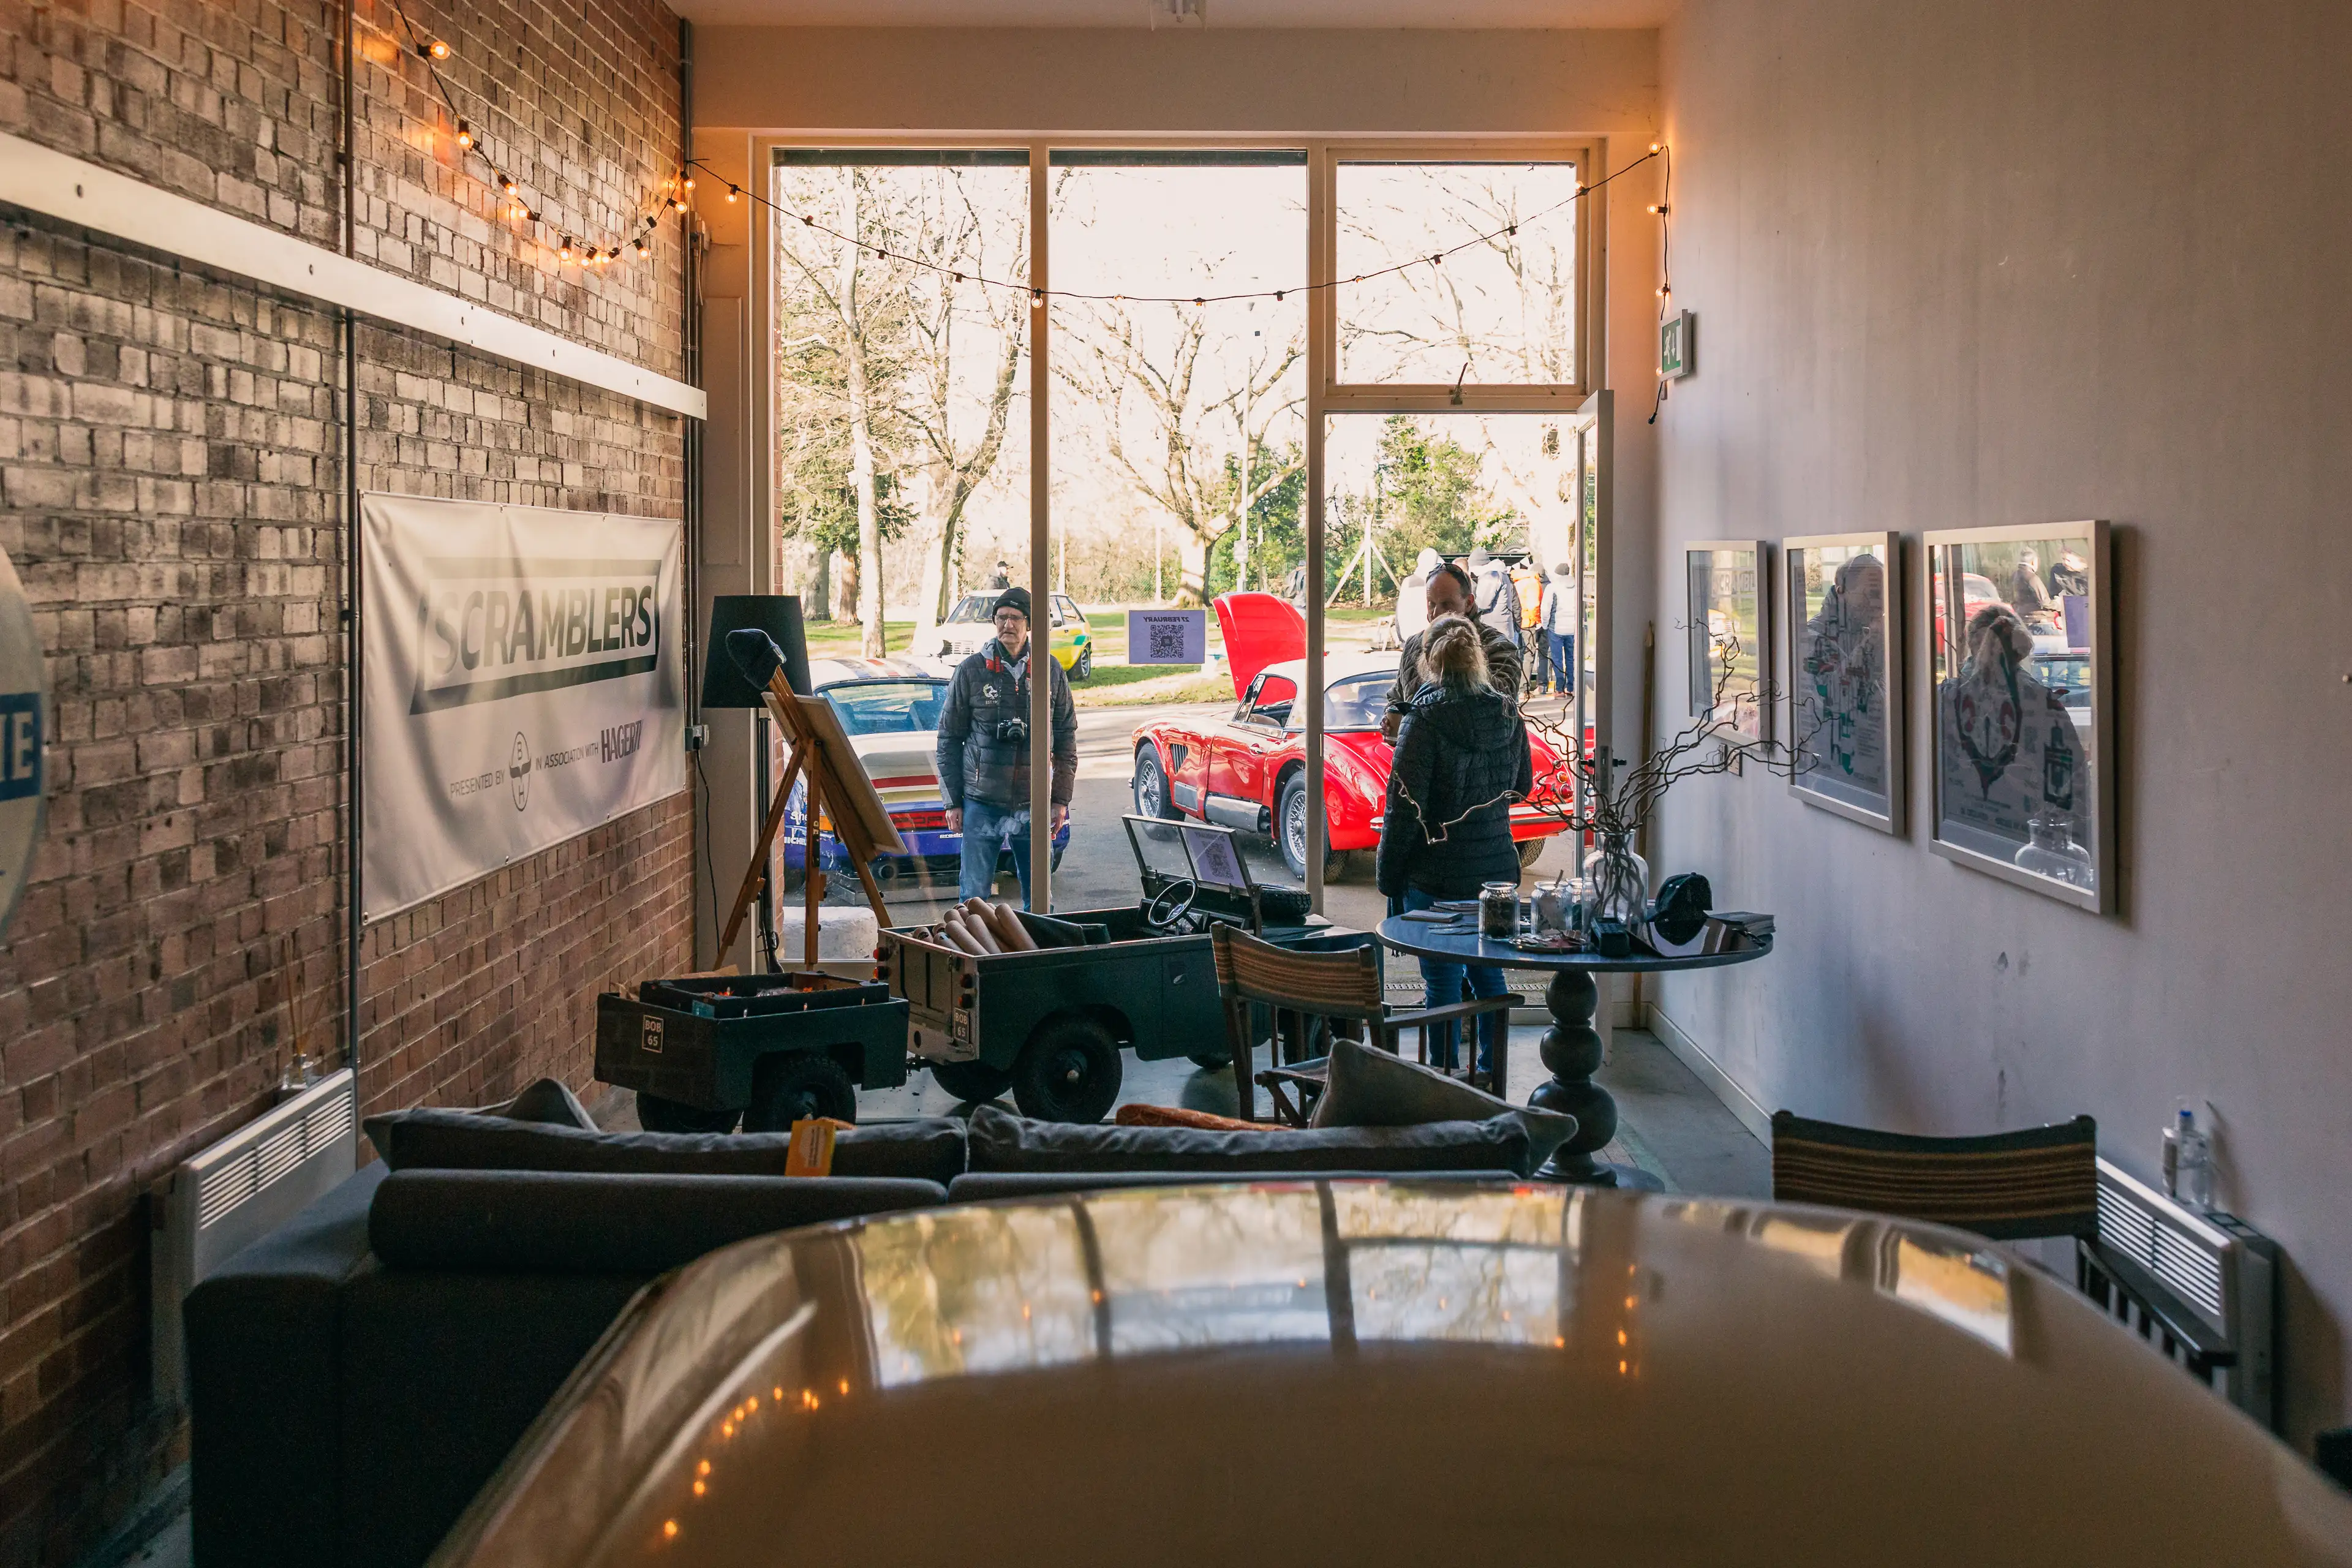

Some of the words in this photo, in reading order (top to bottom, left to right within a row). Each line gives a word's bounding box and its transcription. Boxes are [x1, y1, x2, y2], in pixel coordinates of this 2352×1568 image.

[432, 585, 652, 675] SCRAMBLERS
[516, 741, 523, 760] B
[535, 757, 542, 771] IN
[544, 746, 584, 769] ASSOCIATION
[585, 742, 599, 758] WITH
[450, 773, 492, 799] PRESENTED
[496, 770, 506, 785] BY
[518, 784, 525, 805] H
[644, 1020, 662, 1033] BOB
[955, 1012, 968, 1025] BOB
[647, 1035, 658, 1047] 65
[957, 1026, 966, 1037] 65
